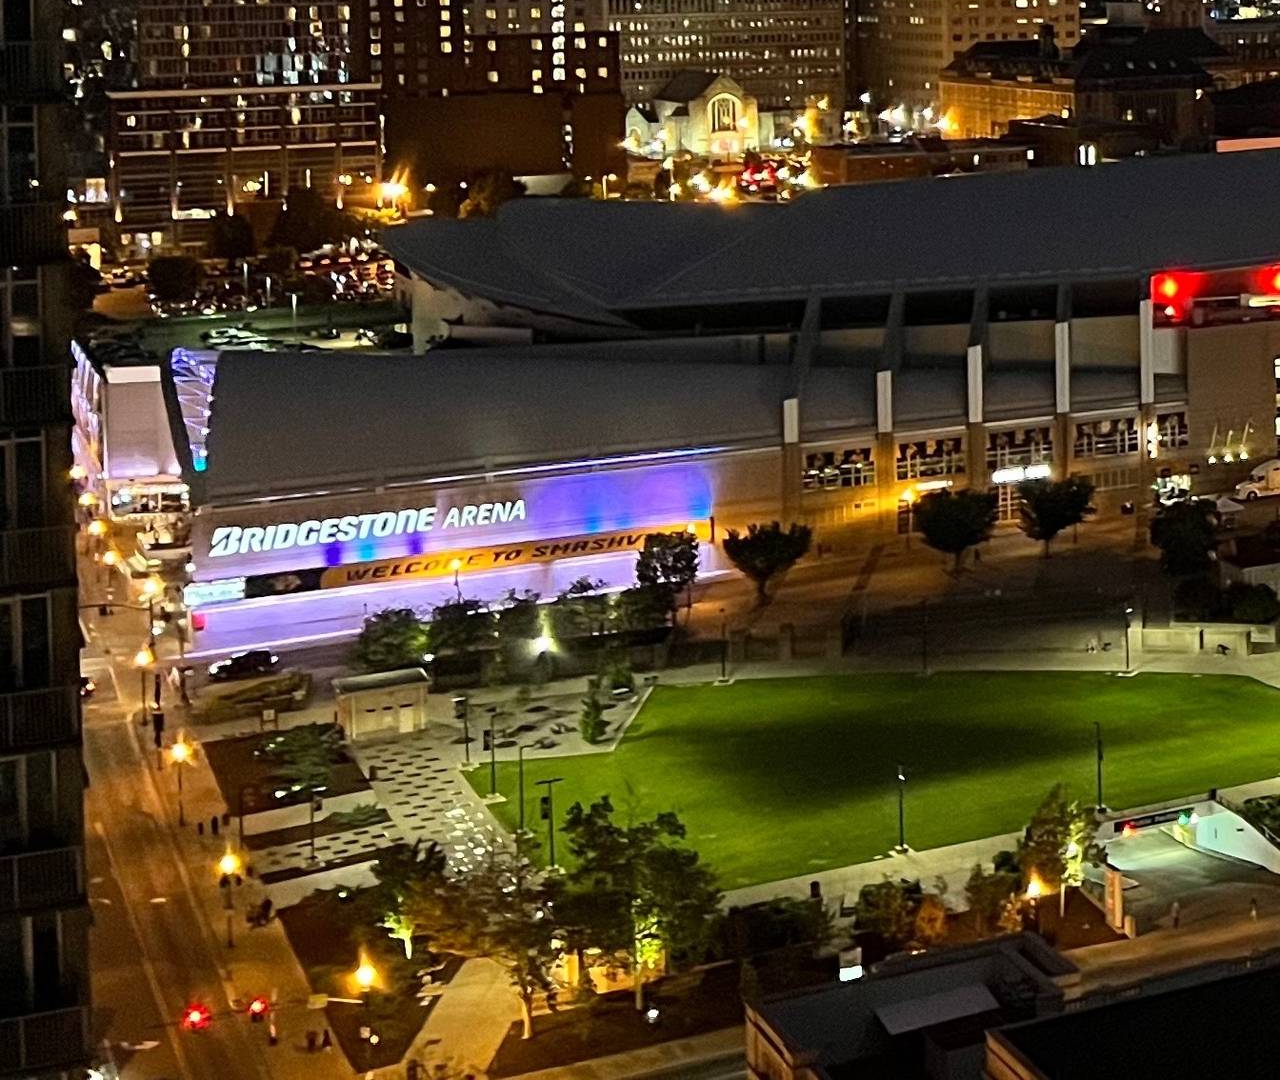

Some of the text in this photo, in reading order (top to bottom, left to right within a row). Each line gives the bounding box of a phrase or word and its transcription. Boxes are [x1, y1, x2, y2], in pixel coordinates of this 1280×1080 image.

[209, 500, 525, 557] BRIDGESTONE ARENA
[492, 549, 522, 562] TO
